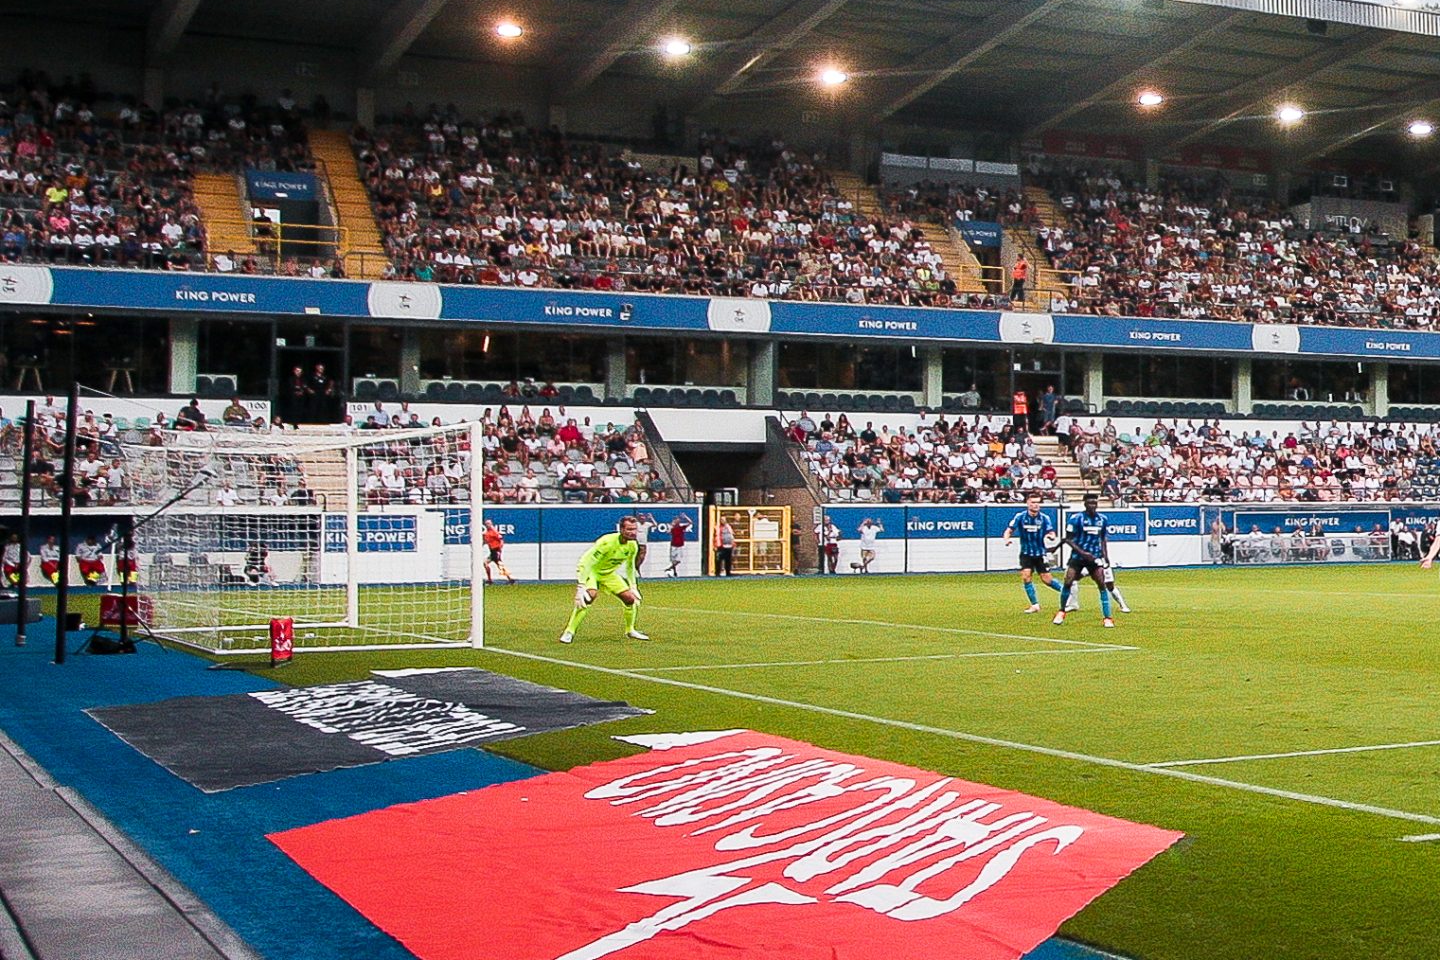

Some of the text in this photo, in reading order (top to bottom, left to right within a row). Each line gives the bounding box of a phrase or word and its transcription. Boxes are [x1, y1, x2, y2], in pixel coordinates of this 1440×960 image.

[175, 290, 256, 304] KING POWER
[544, 306, 613, 318] KING POWER
[858, 320, 918, 331] KING POWER
[1129, 331, 1182, 342] KING POWER
[1365, 341, 1411, 351] KING POWER
[249, 402, 267, 410] 100
[352, 404, 368, 412] 101
[1163, 518, 1197, 528] POWER
[1284, 517, 1340, 527] KING POWER
[1405, 516, 1427, 526] KING
[906, 521, 975, 532] KING POWER
[1106, 525, 1137, 535] OWER
[366, 531, 416, 543] POWER
